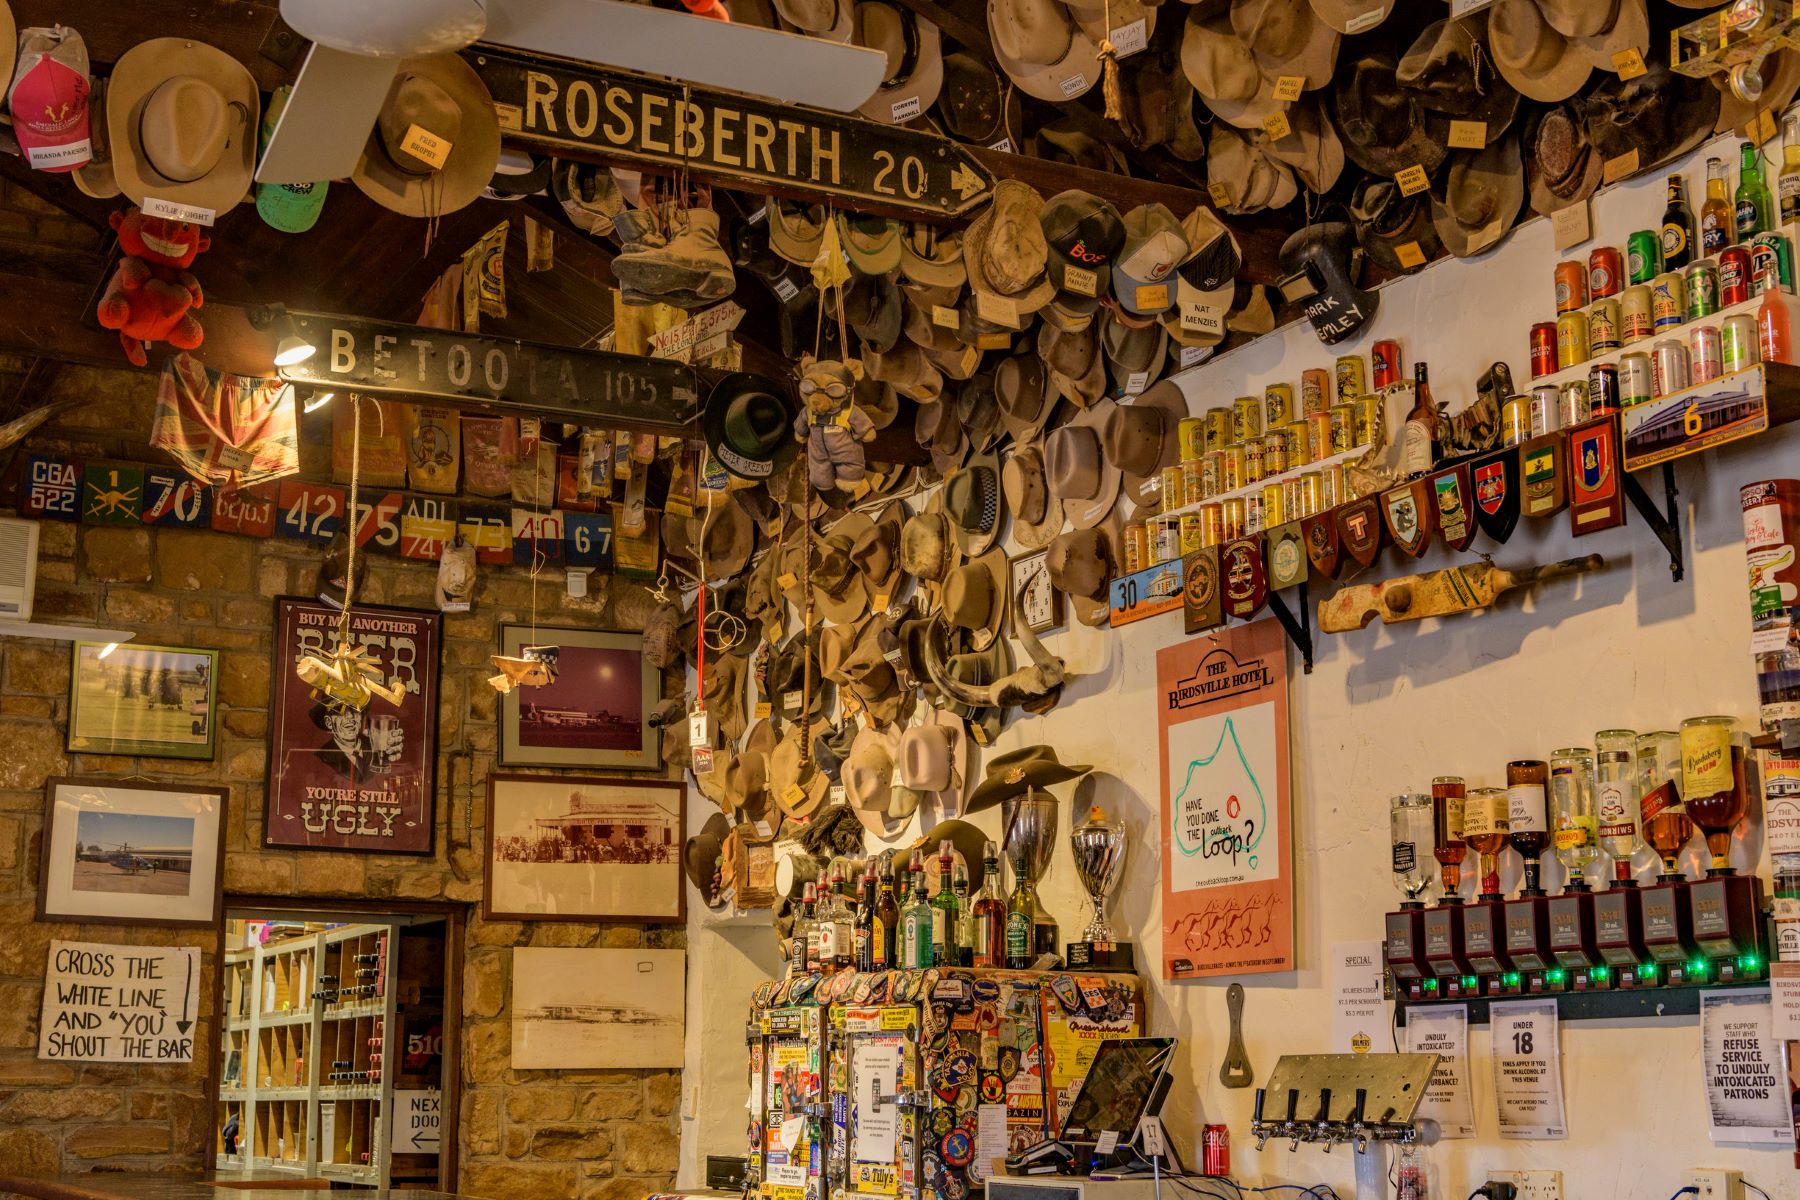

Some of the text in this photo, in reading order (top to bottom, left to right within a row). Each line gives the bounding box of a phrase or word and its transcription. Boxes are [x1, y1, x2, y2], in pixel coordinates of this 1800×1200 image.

[526, 70, 928, 200] ROSEBERTH 20
[1194, 304, 1210, 314] NAT
[1185, 315, 1218, 328] MENZIES
[330, 328, 658, 404] BETOOTA 105
[1684, 402, 1702, 436] 6
[32, 461, 77, 486] CGA
[108, 470, 118, 487] 1
[31, 488, 75, 513] 522
[150, 475, 202, 522] 70
[285, 491, 336, 538] 42
[407, 498, 448, 525] ADL
[346, 503, 399, 546] 75
[1348, 514, 1366, 538] T
[466, 517, 505, 553] 73
[518, 517, 560, 557] 40
[575, 525, 612, 555] 67
[1118, 579, 1136, 612] 30
[299, 612, 327, 626] BUY
[353, 618, 418, 635] ANOTHER
[1206, 660, 1227, 677] THE
[1168, 667, 1274, 709] BIRDSVILLE HOTEL
[695, 723, 701, 738] 1
[1697, 760, 1717, 775] RUM
[359, 790, 399, 804] STILL
[1185, 798, 1202, 812] HAVE
[301, 802, 402, 837] UGLY
[1186, 810, 1219, 827] YOU DONE
[1187, 828, 1200, 841] THE
[1210, 825, 1232, 836] outback
[56, 948, 164, 980] CROSS THE
[1345, 956, 1372, 965] SPECIAL
[57, 983, 166, 1009] WHITE LINE
[1084, 990, 1099, 998] SES
[53, 1011, 102, 1031] AND
[1069, 1020, 1130, 1034] Queensland
[1513, 1021, 1534, 1029] UNDER
[48, 1032, 192, 1060] SHOUT THE BAR
[1416, 1042, 1455, 1050] INTOXICATED?
[1425, 1033, 1446, 1041] UNDULY
[1512, 1032, 1534, 1055] 18
[1723, 1039, 1759, 1050] REFUSE
[1722, 1051, 1762, 1062] SERVICE
[1716, 1064, 1770, 1074] TO UNDULY
[1714, 1076, 1776, 1087] INTOXICATED
[1724, 1088, 1769, 1099] PATRONS
[1146, 1124, 1157, 1138] 17
[871, 1168, 894, 1190] Tilly's
